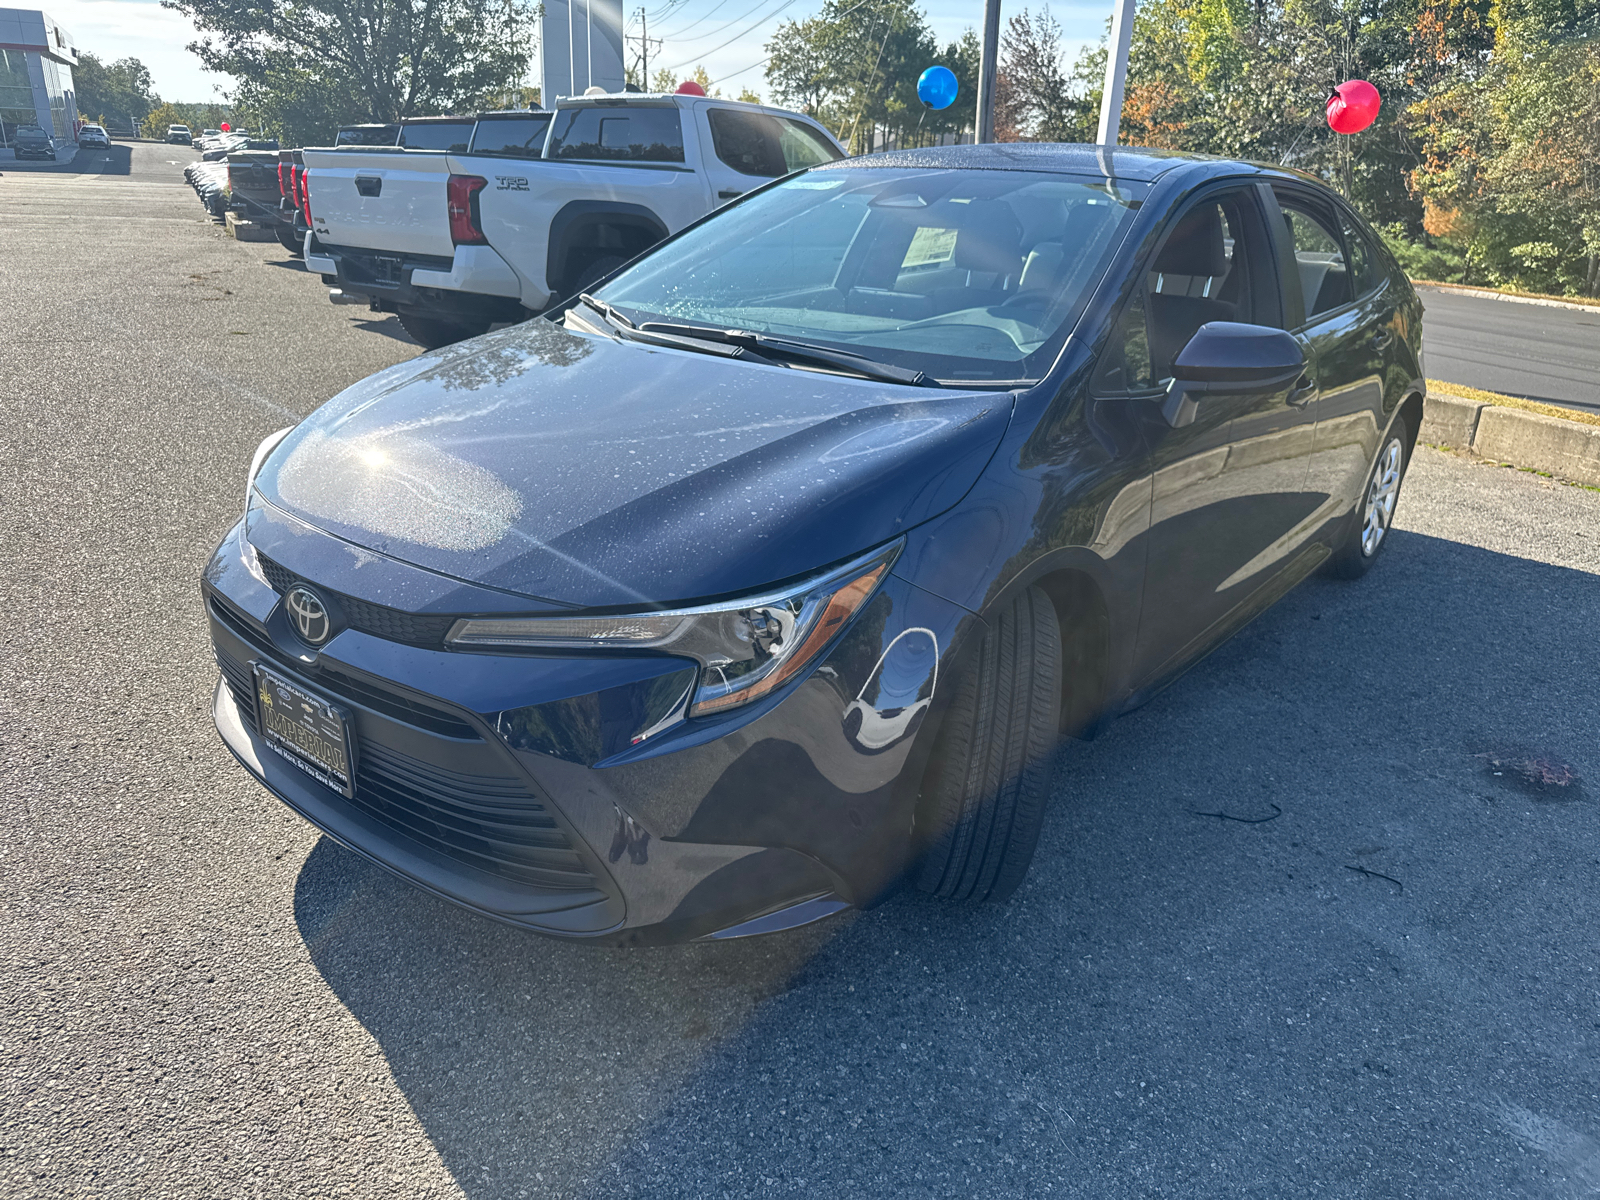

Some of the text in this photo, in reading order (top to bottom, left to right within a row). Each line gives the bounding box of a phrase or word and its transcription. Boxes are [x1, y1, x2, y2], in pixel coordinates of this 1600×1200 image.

[495, 176, 529, 187] TRD
[263, 705, 347, 774] IMPERIAL
[267, 728, 348, 781] www.imperialcars.com
[265, 740, 274, 750] We
[297, 760, 304, 770] So
[305, 764, 315, 776] You
[328, 780, 343, 794] More
